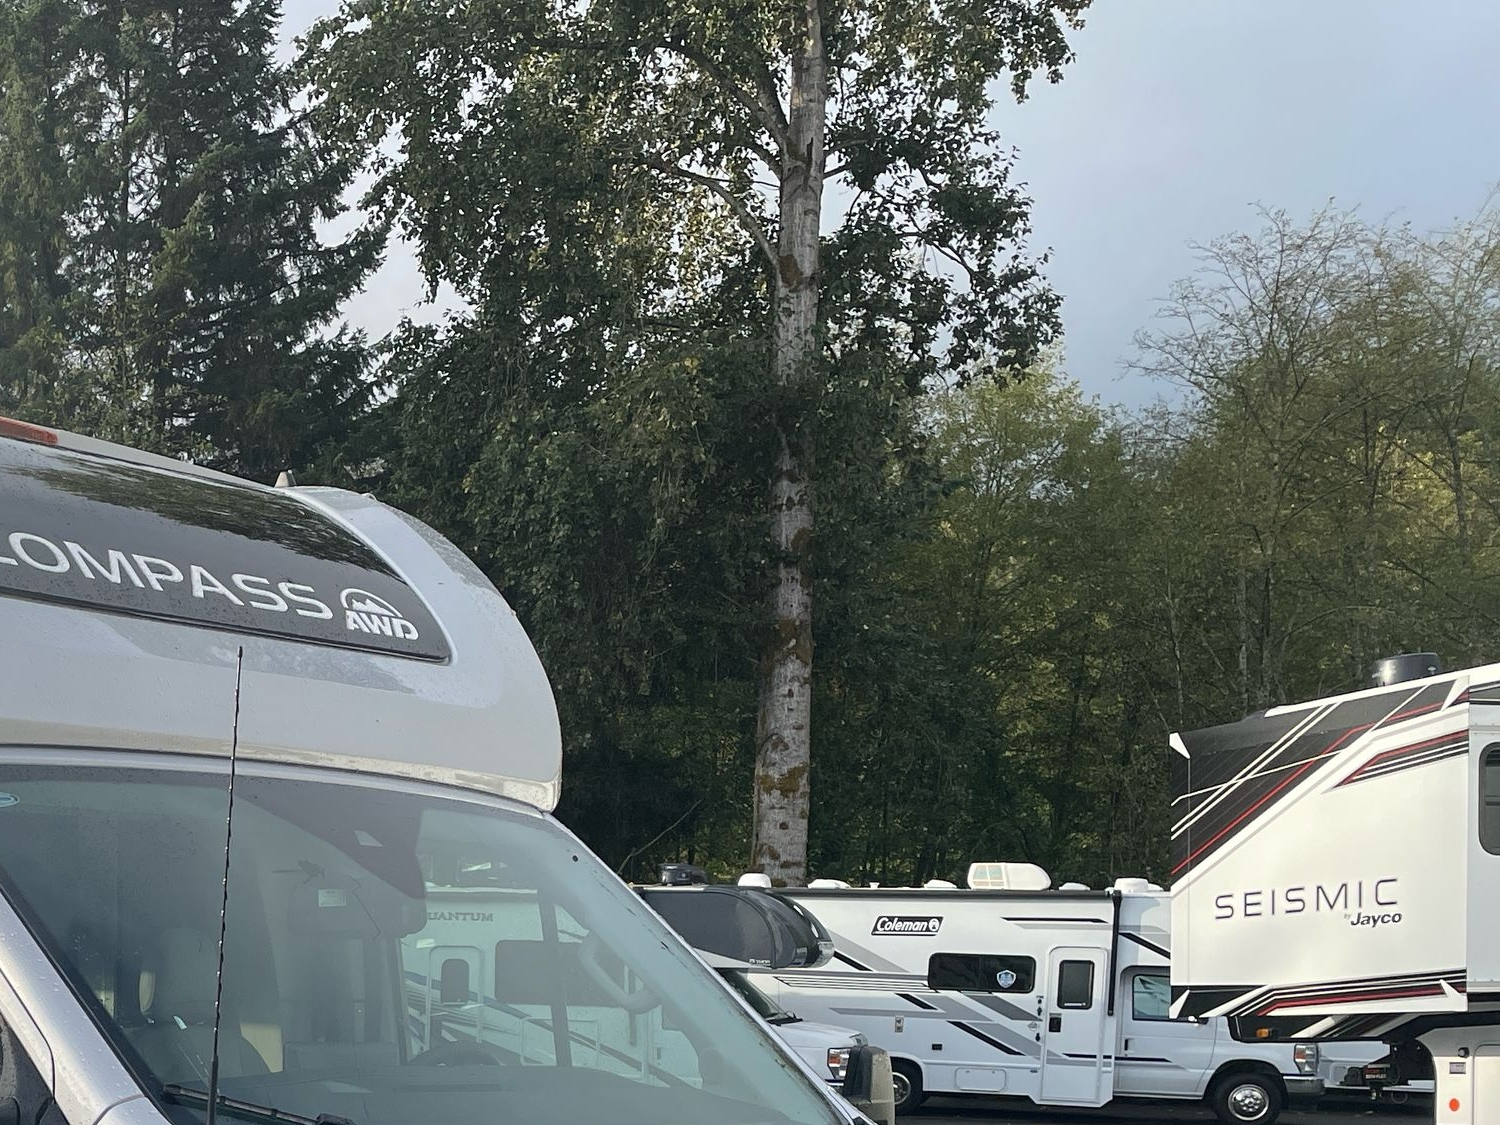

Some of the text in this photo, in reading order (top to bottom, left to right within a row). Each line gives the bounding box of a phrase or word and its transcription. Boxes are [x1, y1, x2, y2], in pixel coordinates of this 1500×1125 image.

[345, 610, 419, 641] AWD
[1214, 878, 1398, 920] SEISMIC
[427, 911, 494, 922] UANTUM
[876, 916, 929, 932] Coleman
[1350, 911, 1403, 928] Jayco
